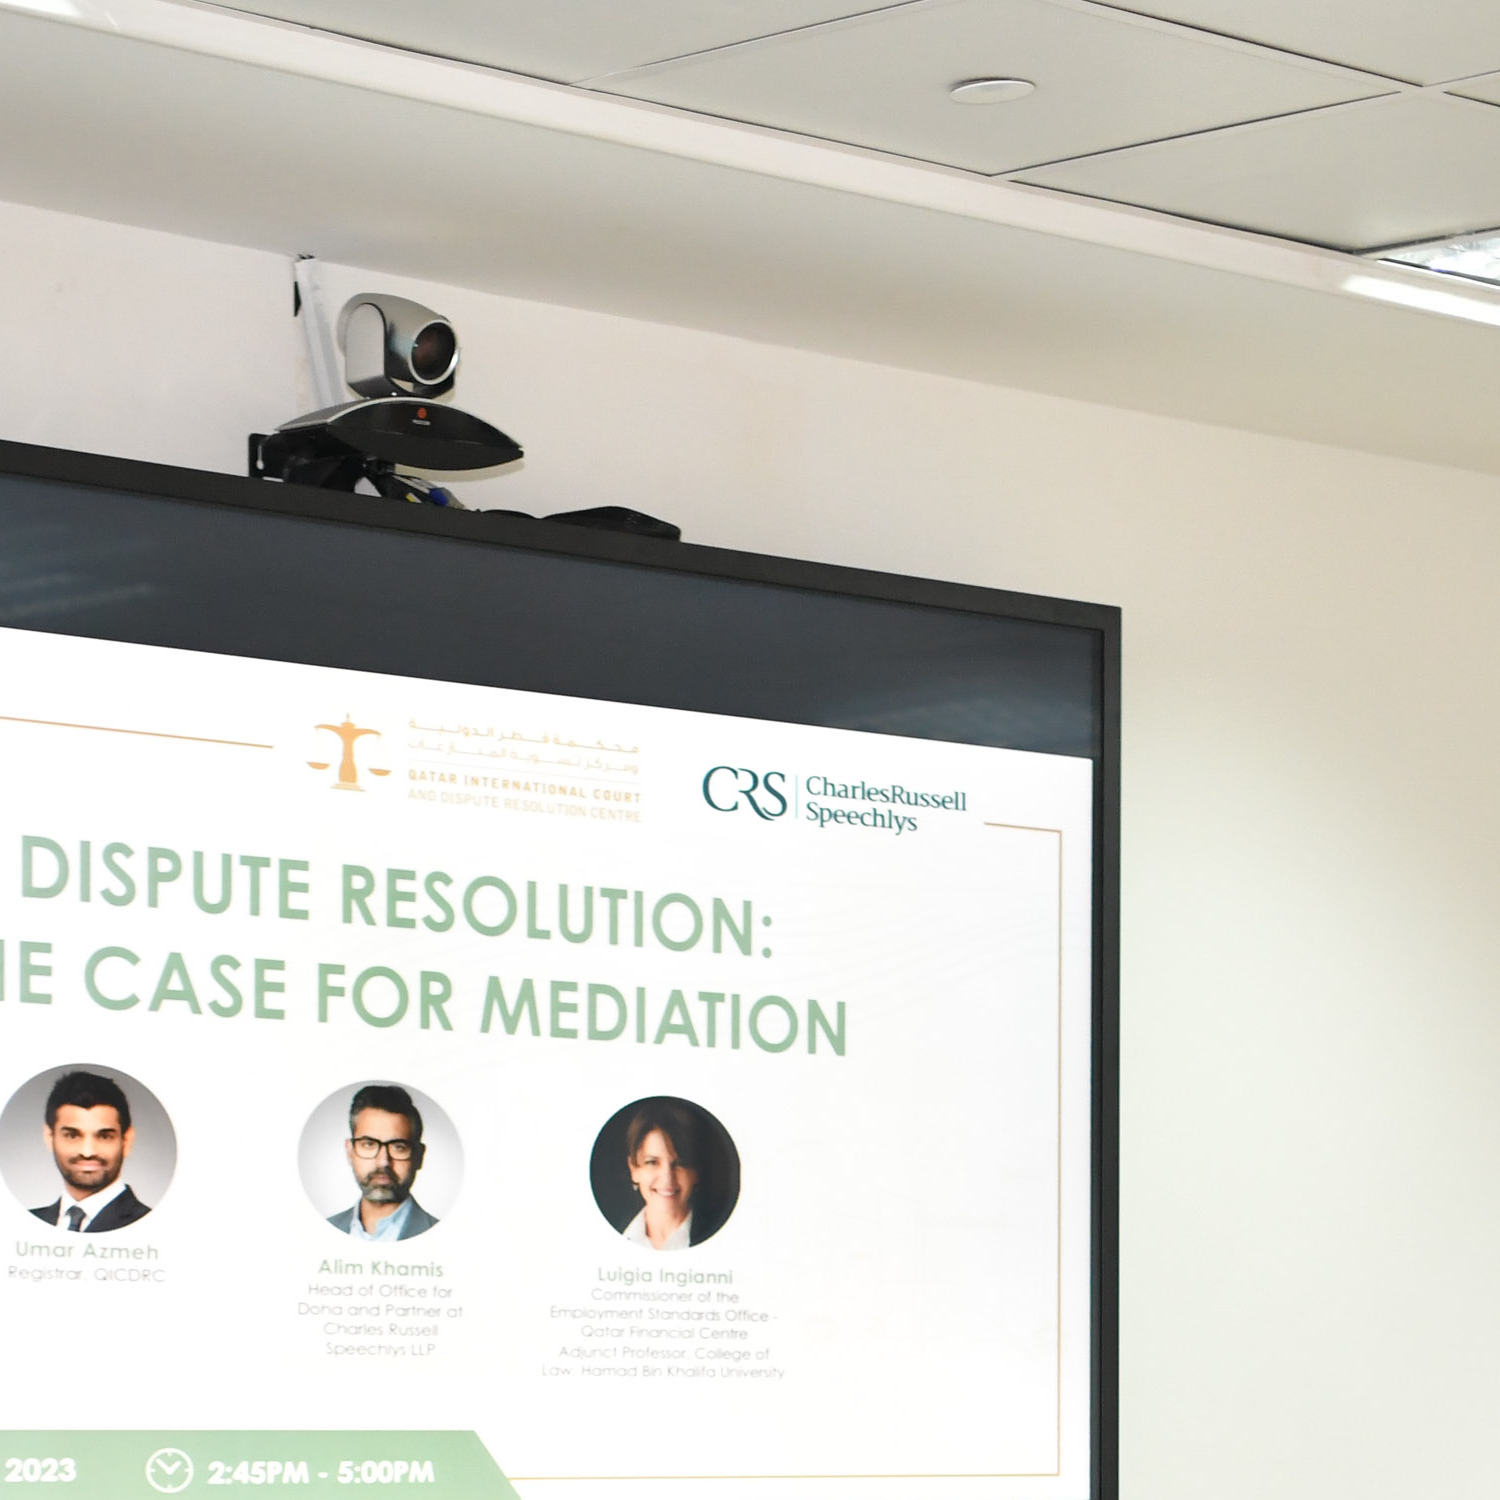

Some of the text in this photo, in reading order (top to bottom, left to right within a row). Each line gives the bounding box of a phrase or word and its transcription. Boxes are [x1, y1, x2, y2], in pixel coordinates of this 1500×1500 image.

[409, 768, 641, 803] QATAR INTERNATIONAL COURT
[701, 765, 788, 821] CRS
[805, 775, 967, 812] CharlesRussell
[408, 788, 642, 822] AND DISPUTE RESOLUTION CENTRE
[805, 802, 918, 836] Speechlys
[21, 835, 775, 958] DISPUTE RESOLUTION:
[84, 945, 286, 1021] CASE
[317, 963, 454, 1033] FOR
[481, 975, 848, 1057] MEDIATION
[15, 1240, 159, 1261] Umar Azmeh
[94, 1267, 165, 1283] QICDRC
[318, 1259, 444, 1278] Alim Khamis
[598, 1267, 733, 1287] Luigia Ingianni
[308, 1283, 452, 1299] Head of Office for
[591, 1287, 739, 1303] Commissioner of the
[297, 1302, 463, 1318] Doha and Partner at
[550, 1305, 643, 1320] Employment
[648, 1307, 720, 1321] Standards
[724, 1308, 769, 1322] Office
[323, 1322, 439, 1337] Charles Russell
[581, 1325, 748, 1340] Qatar Financial Centre
[325, 1341, 436, 1358] Speechlys LLP
[558, 1346, 616, 1361] Adjunct
[695, 1347, 751, 1362] College
[755, 1348, 770, 1360] of
[581, 1365, 637, 1377] Hamad
[642, 1365, 662, 1377] Bin
[667, 1365, 716, 1378] Khalifa
[720, 1366, 785, 1380] University
[5, 1457, 76, 1483] 2023
[207, 1459, 308, 1486] 2:45PM
[338, 1459, 434, 1485] 5:00PM
